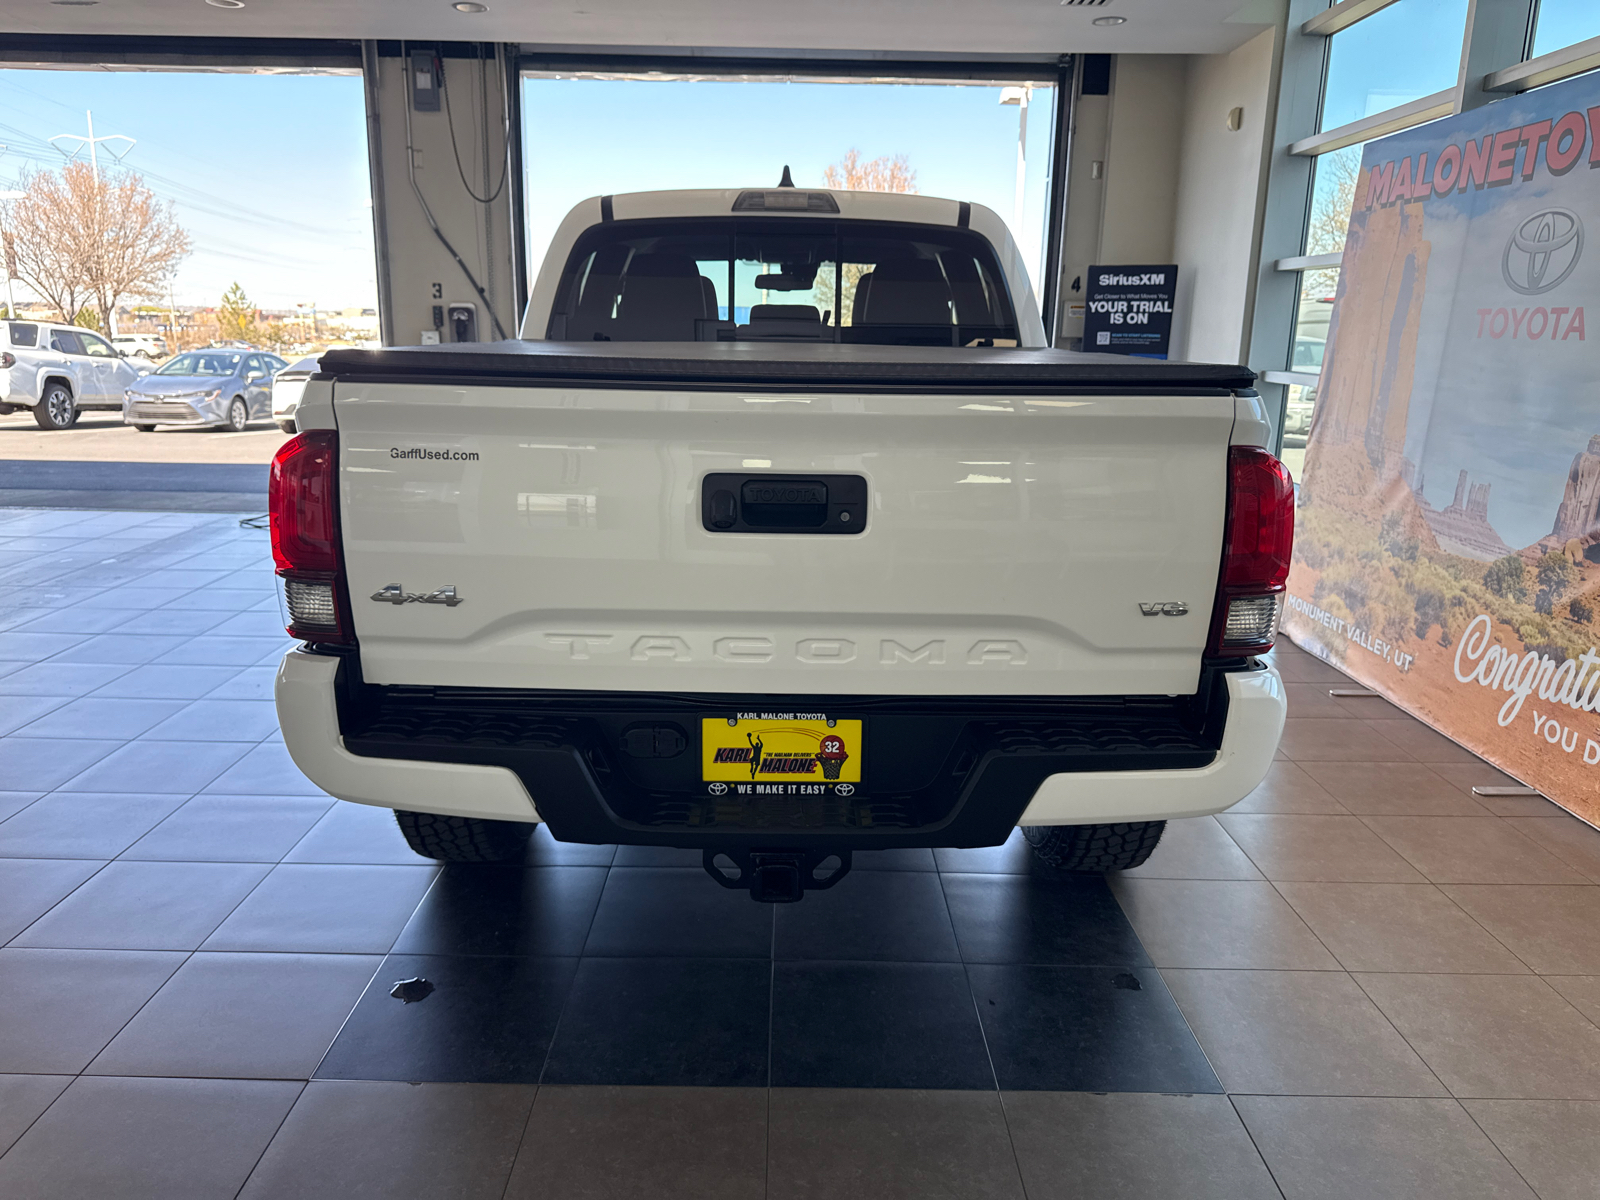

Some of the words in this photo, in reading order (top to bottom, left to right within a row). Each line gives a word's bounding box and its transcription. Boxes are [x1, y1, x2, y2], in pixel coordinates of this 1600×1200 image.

[1071, 275, 1081, 293] 4
[1099, 274, 1165, 285] SiriusXM
[432, 282, 443, 298] 3
[1089, 301, 1127, 312] YOUR
[1130, 301, 1172, 312] TRIAL
[1110, 313, 1124, 324] IS
[1126, 312, 1148, 324] ON
[1476, 306, 1586, 341] TOYOTA
[390, 447, 480, 461] GarffUsed.com
[750, 487, 820, 503] TOYOTA
[370, 582, 464, 607] 4x4
[1138, 597, 1188, 616] V6
[1288, 594, 1344, 634] MONUMENT
[1346, 623, 1391, 664] VALLEY,
[1394, 649, 1413, 671] UT
[543, 633, 1028, 664] TACOMA
[796, 713, 827, 721] TOYOTA
[1533, 710, 1578, 753] YOU
[824, 741, 840, 753] 32
[713, 748, 752, 763] KARL
[759, 758, 818, 774] MALONE
[737, 784, 753, 794] WE
[756, 784, 784, 795] MAKE
[787, 784, 797, 795] IT
[800, 784, 826, 795] EASY
